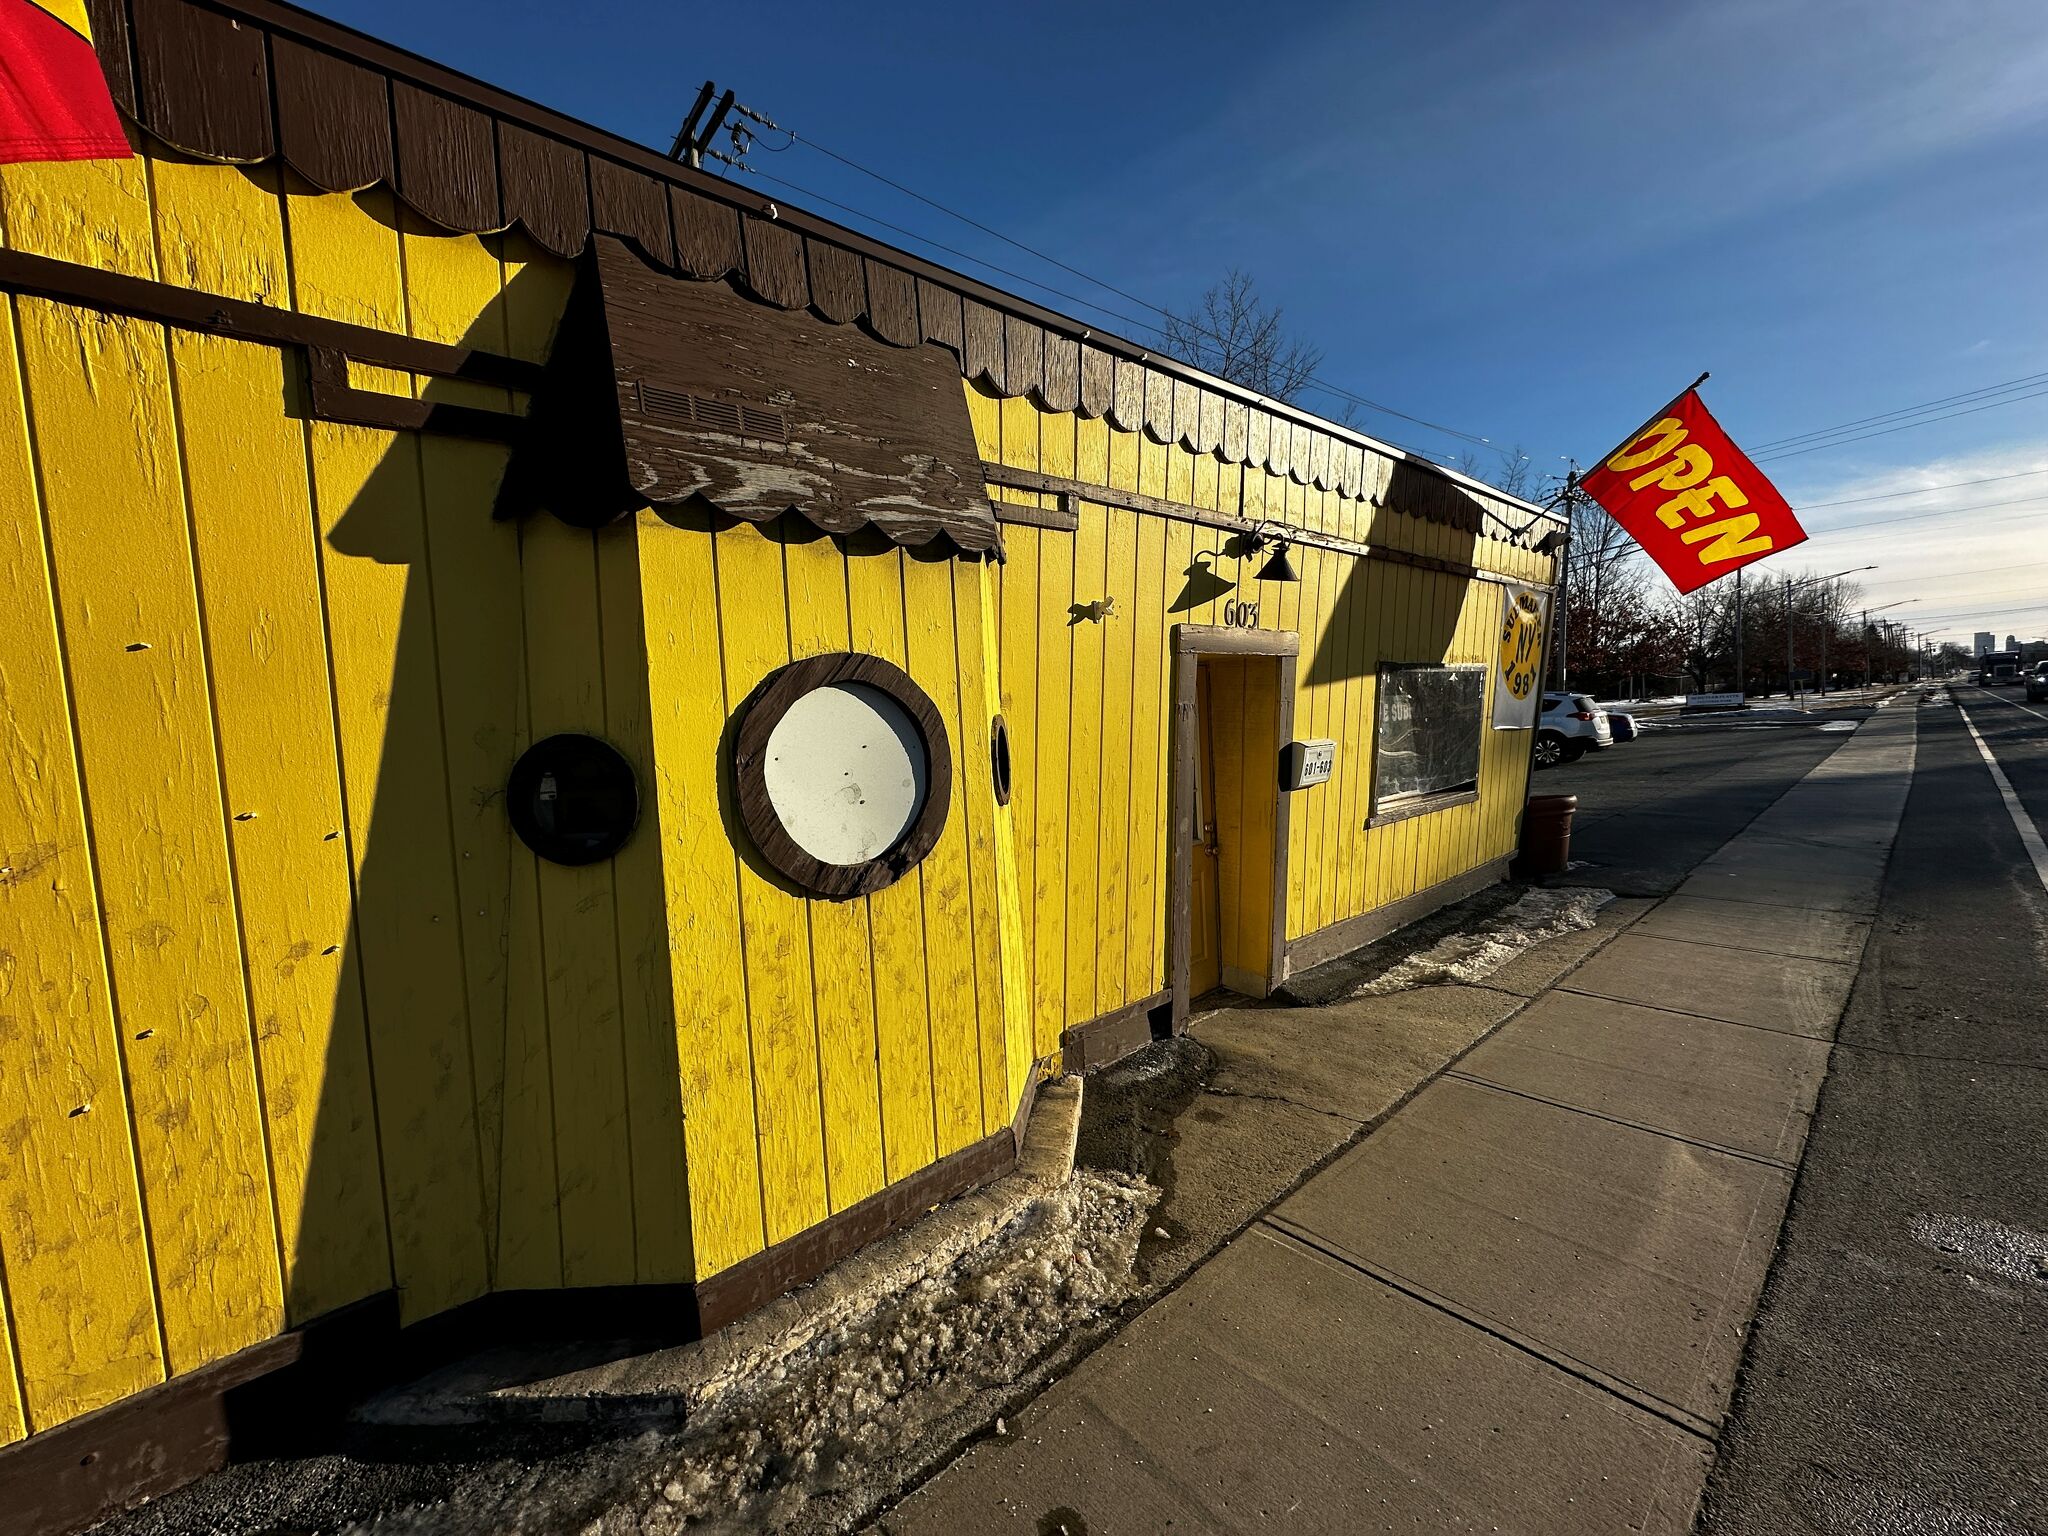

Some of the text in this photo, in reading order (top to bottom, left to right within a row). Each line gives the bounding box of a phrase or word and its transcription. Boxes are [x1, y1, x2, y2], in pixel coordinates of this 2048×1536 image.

[1607, 417, 1773, 565] OPEN
[1224, 598, 1258, 628] 603
[1515, 623, 1537, 664] NY
[1304, 760, 1332, 776] 601-603
